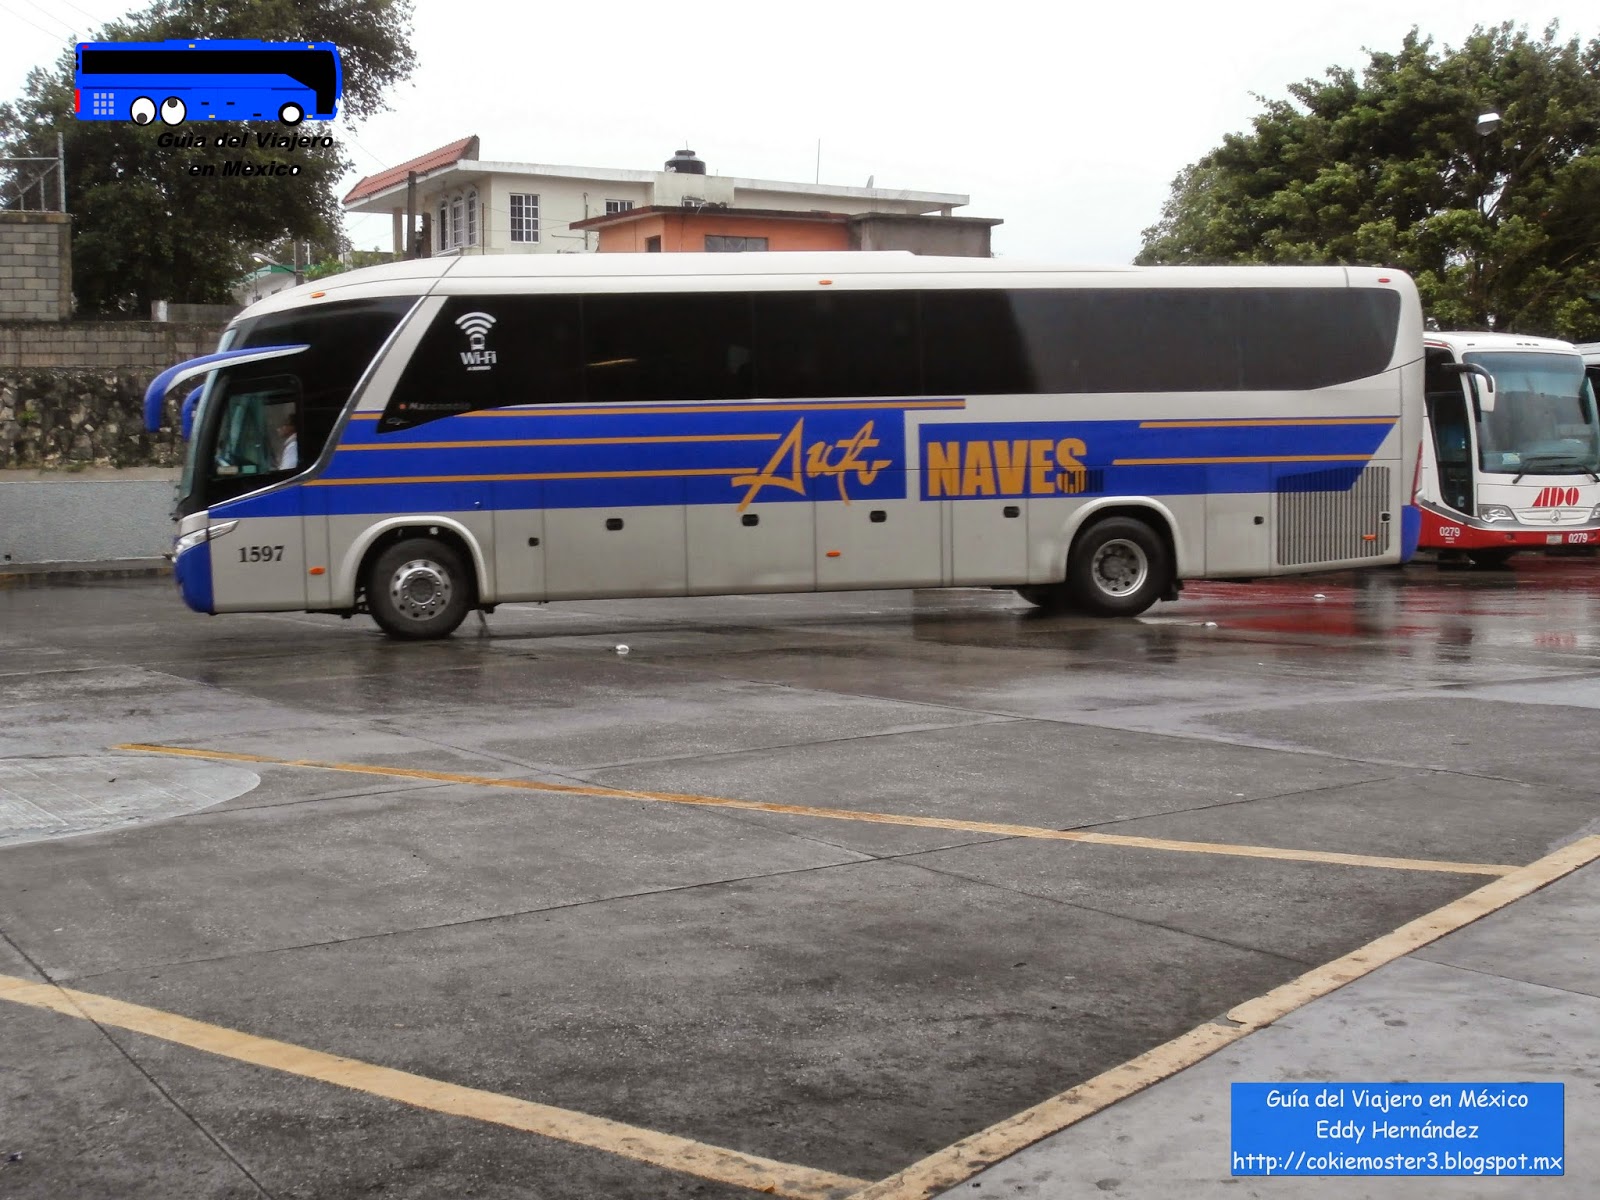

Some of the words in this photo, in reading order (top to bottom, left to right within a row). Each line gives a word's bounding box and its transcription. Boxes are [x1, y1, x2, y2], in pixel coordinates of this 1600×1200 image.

[460, 351, 497, 365] Wi-Fi
[927, 438, 1087, 497] NAVES
[1532, 487, 1580, 507] ADO
[1439, 526, 1461, 538] 0279
[1568, 532, 1588, 544] 0279
[239, 545, 285, 564] 1597
